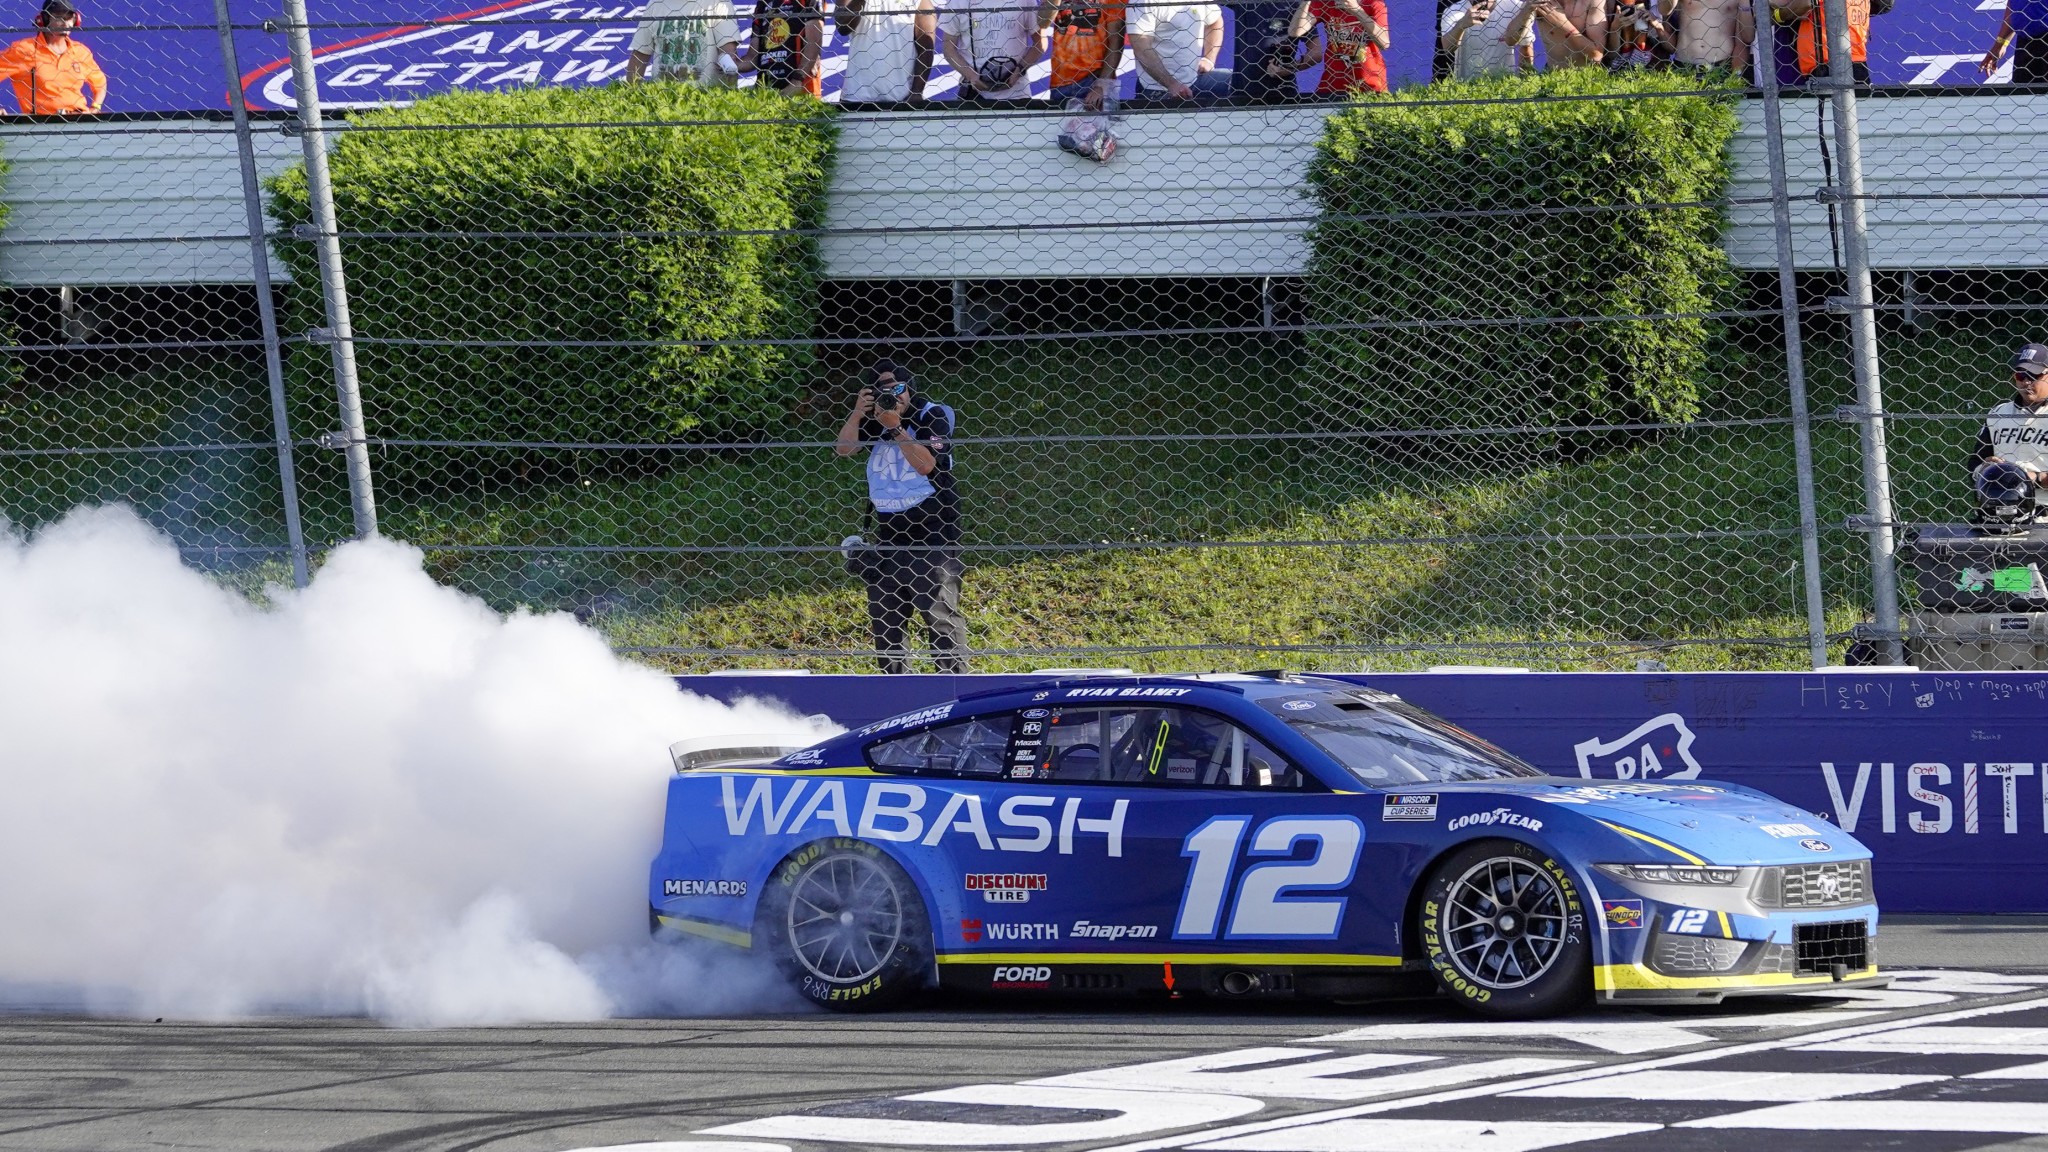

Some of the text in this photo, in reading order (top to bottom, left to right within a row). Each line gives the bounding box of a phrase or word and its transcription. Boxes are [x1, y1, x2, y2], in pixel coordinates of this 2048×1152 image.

[1993, 427, 2048, 446] OFFICIA
[1066, 688, 1191, 697] RYAN BLANEY
[880, 704, 954, 729] ADVANCE
[903, 712, 949, 729] AUTO PARTS
[1024, 723, 1041, 733] PPG
[1168, 765, 1195, 774] verizon
[1401, 796, 1430, 804] NASCAR
[1821, 763, 2048, 833] VISIT
[722, 777, 1130, 858] WABASH
[965, 873, 1048, 891] DISCOUNT
[1172, 815, 1365, 940] 12
[1544, 858, 1580, 911] EAGLE
[664, 879, 747, 896] MENARDS
[988, 891, 1024, 901] TIRE
[1605, 911, 1641, 920] SUNOCO
[1667, 910, 1709, 933] 12
[986, 923, 1059, 940] WÜRTH
[1070, 920, 1158, 941] Snap-on
[993, 966, 1051, 981] FORD
[830, 975, 882, 1000] EAGLE
